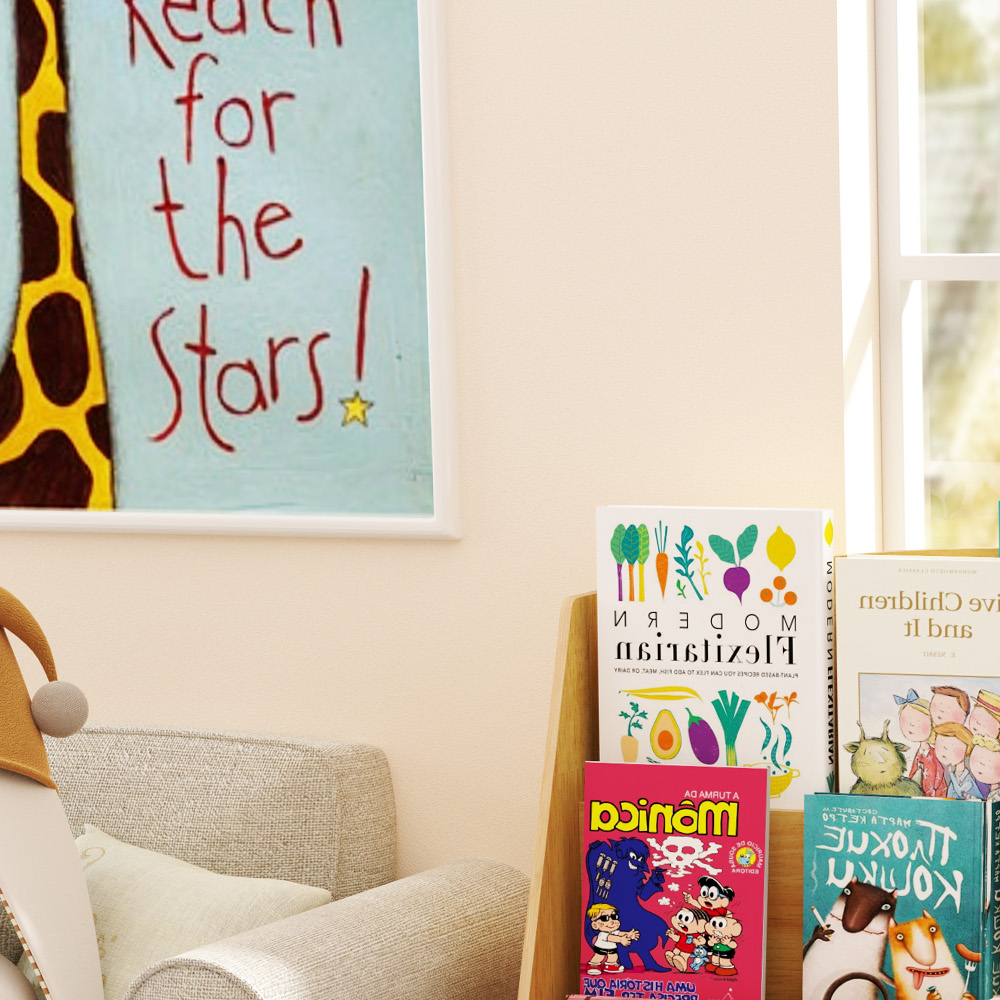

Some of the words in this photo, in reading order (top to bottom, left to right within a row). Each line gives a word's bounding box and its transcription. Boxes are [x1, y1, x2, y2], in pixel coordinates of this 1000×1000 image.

[174, 52, 296, 164] for
[153, 156, 302, 279] the
[148, 266, 372, 452] Stars!
